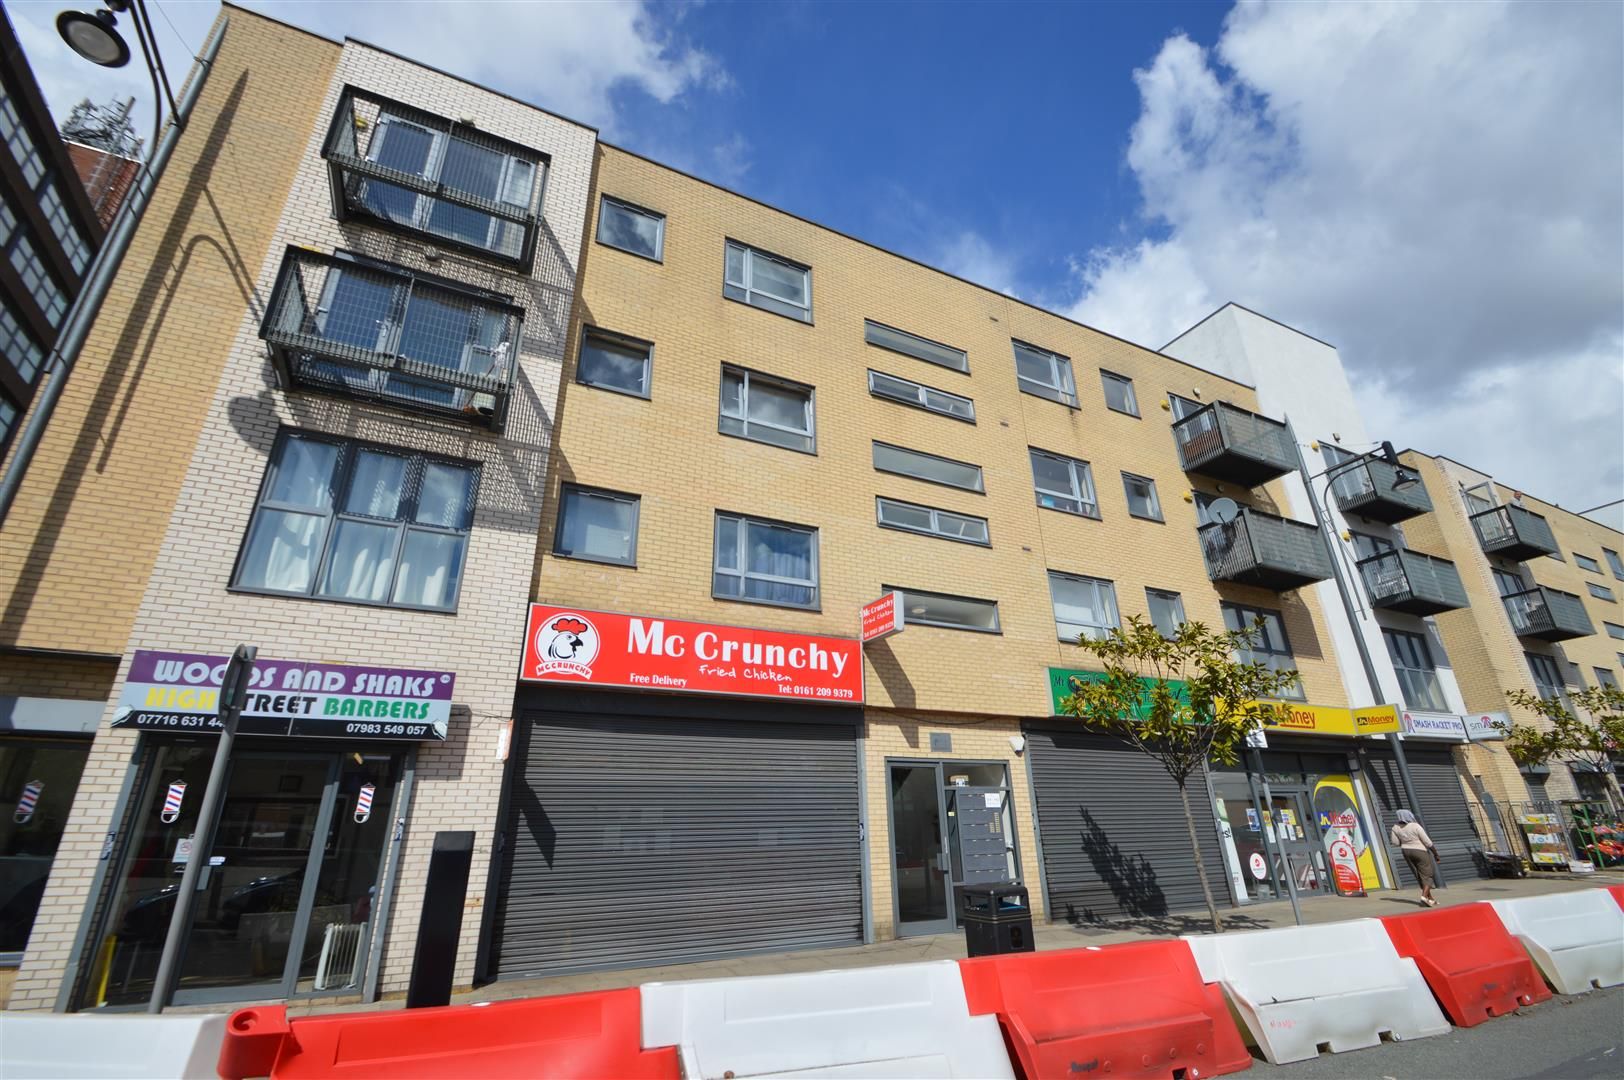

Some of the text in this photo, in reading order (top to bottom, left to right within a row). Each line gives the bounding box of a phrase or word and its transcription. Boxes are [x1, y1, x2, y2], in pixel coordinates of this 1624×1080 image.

[628, 618, 849, 678] Mc Crunchy
[630, 672, 688, 688] Free Delivery
[699, 664, 792, 682] Fried Chicken
[282, 669, 346, 692] AND
[352, 673, 436, 697] SHAKS
[794, 685, 814, 695] 0161
[816, 687, 831, 697] 209
[833, 688, 853, 698] 9379
[144, 687, 431, 719] HIGH TREET BARBERS
[137, 713, 427, 735] 07716 631 44 07983 549 057
[1368, 715, 1394, 724] Money
[1413, 719, 1463, 730] SMASH RACKET PRO
